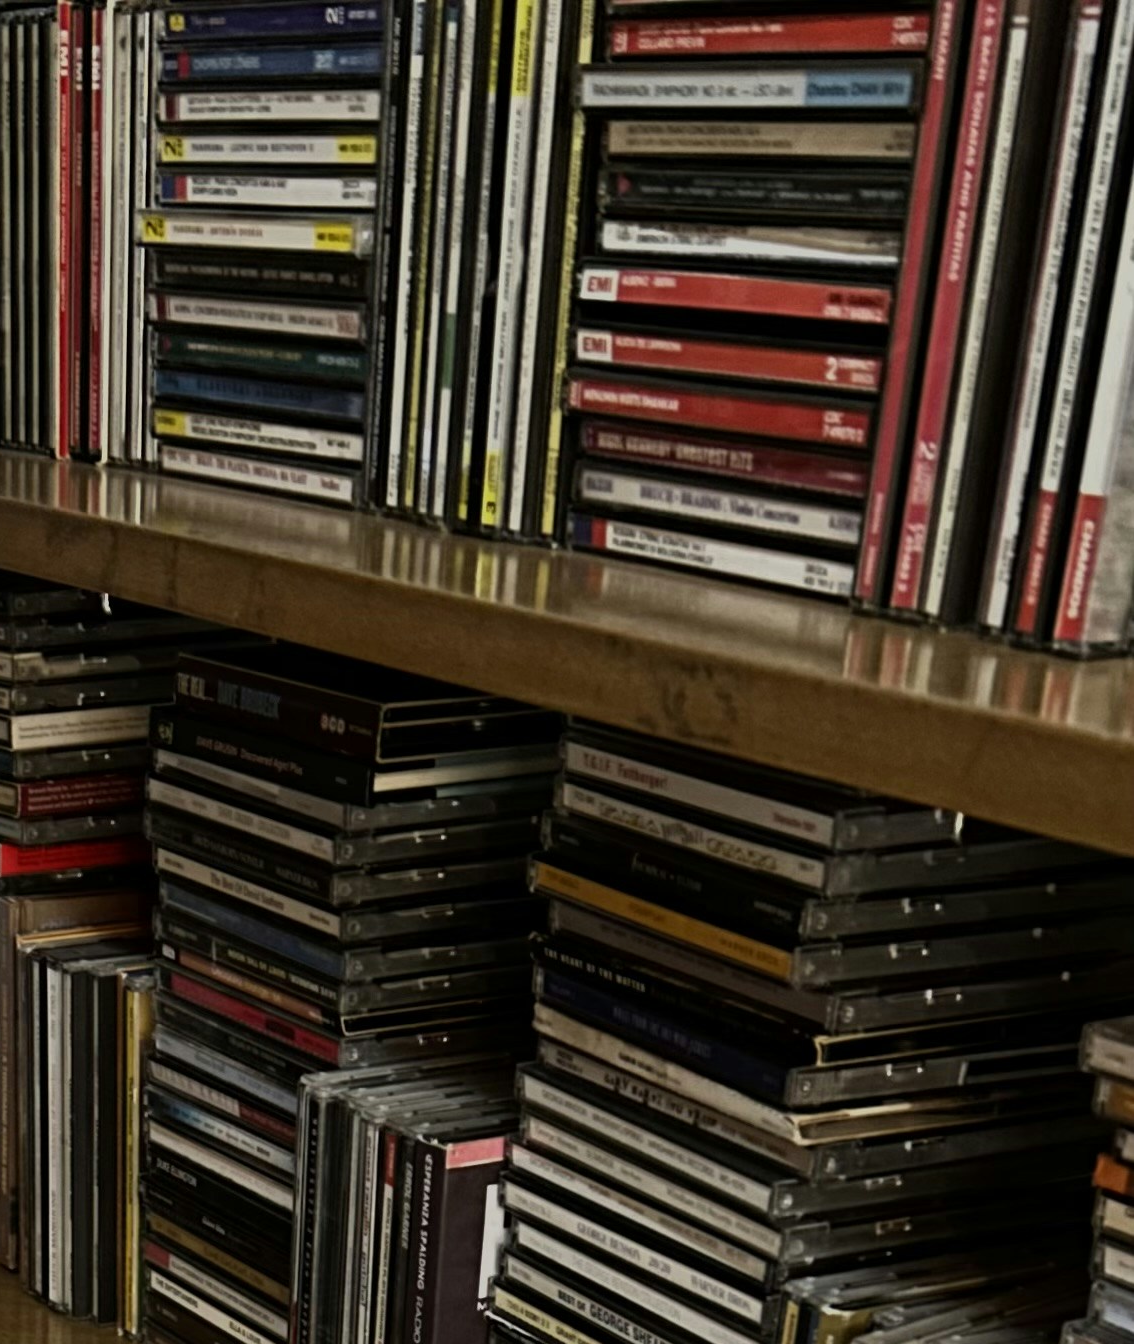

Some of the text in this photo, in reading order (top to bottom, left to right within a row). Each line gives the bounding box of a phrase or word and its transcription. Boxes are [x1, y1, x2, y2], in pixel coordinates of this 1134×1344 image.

[60, 29, 70, 76] EMI
[73, 47, 83, 90] EMI
[90, 44, 102, 90] EMI
[962, 89, 986, 166] SONATAS
[957, 168, 974, 207] AND
[946, 208, 968, 280] PARTITAS
[585, 275, 614, 297] EMI
[581, 335, 839, 382] EMI 2
[916, 438, 937, 461] 2
[1065, 518, 1096, 621] CHANDOS
[540, 945, 647, 993] THE HEART OF THE MATTER
[419, 1153, 434, 1228] ESPERANZA
[414, 1228, 429, 1291] SPALDING
[411, 1294, 424, 1344] RADIO
[554, 1287, 578, 1306] BEST
[585, 1302, 635, 1337] GEORGE
